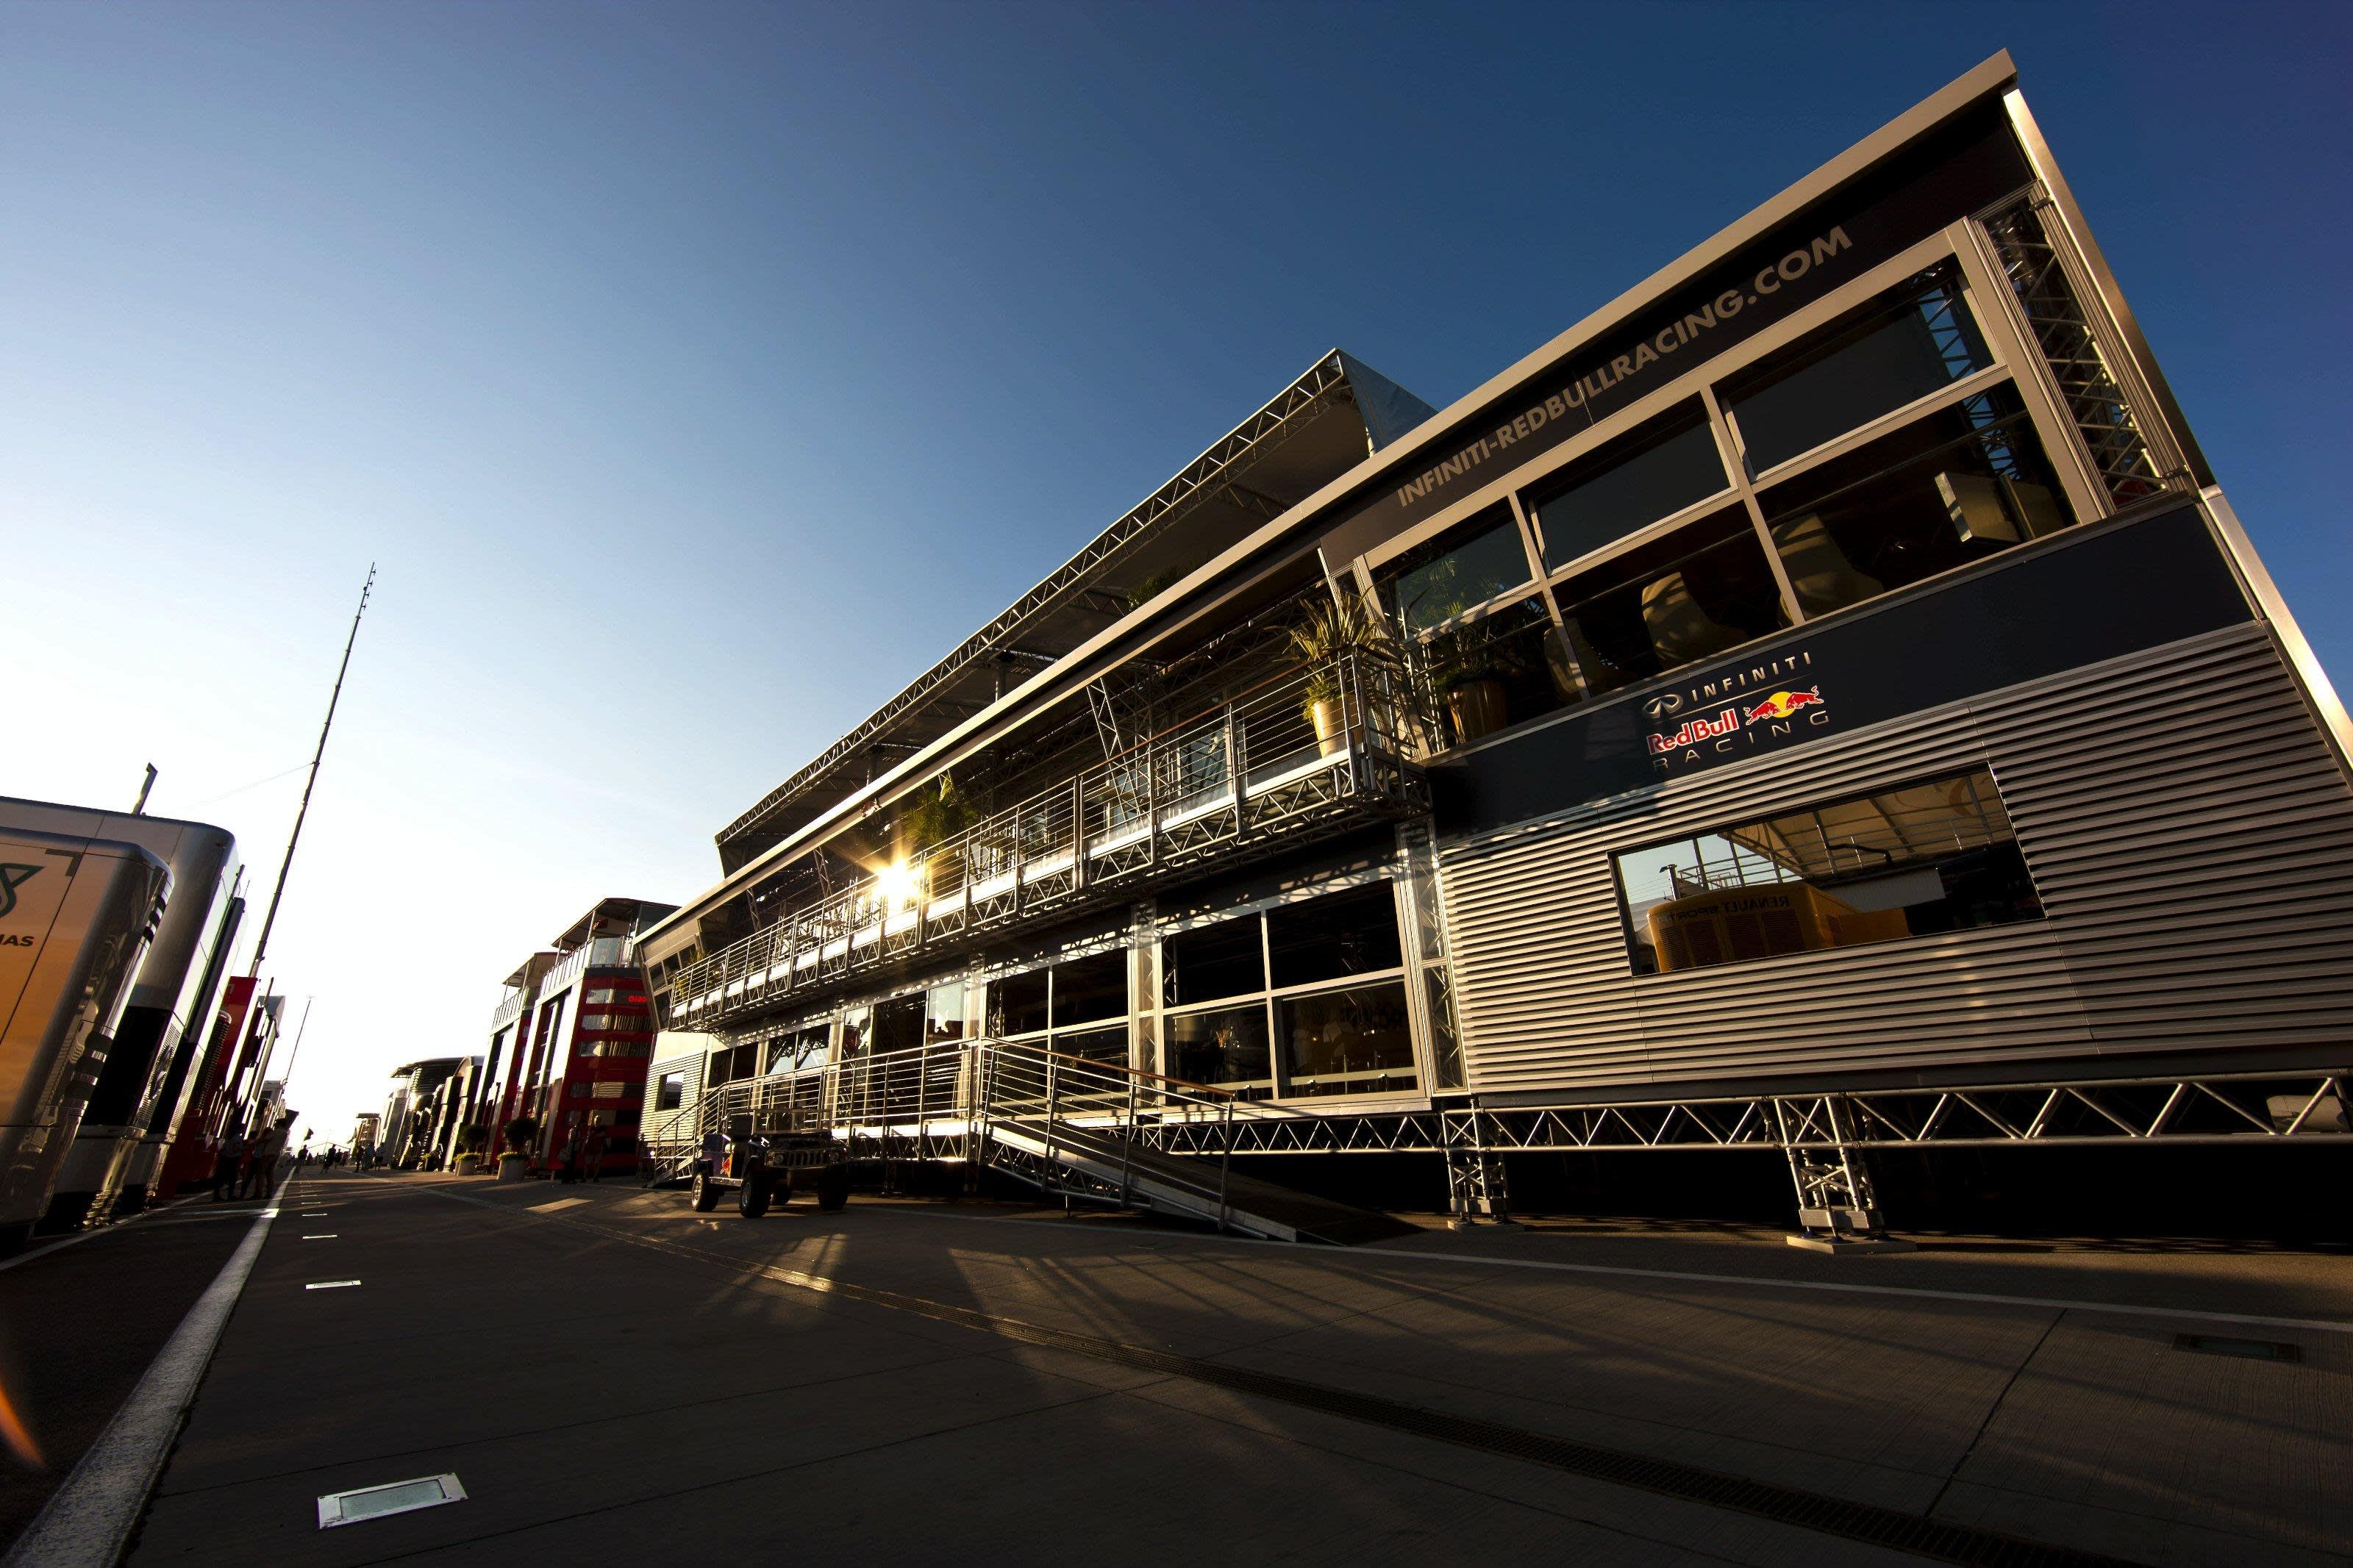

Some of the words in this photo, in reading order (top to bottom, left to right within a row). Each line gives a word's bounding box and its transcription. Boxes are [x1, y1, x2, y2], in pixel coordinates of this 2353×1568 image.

[1398, 226, 1852, 507] INFINITI-REDBULLRACING.COM
[1691, 652, 1812, 701] INFINITI
[1652, 710, 1829, 770] RACING
